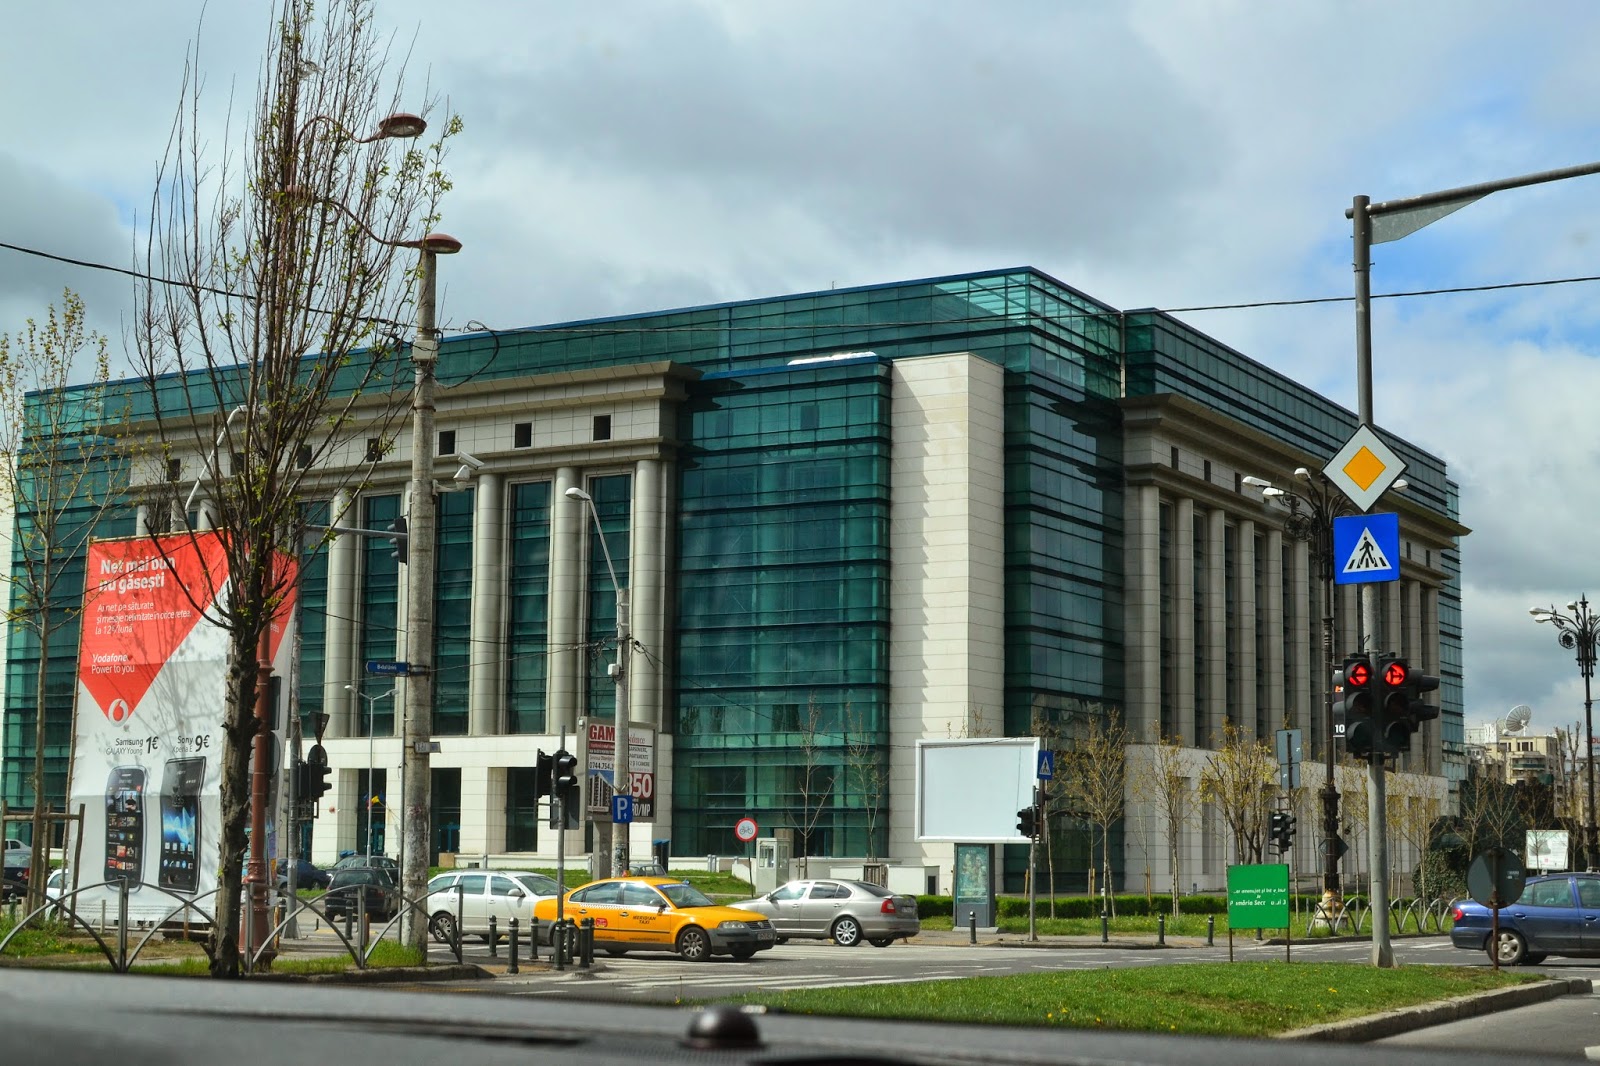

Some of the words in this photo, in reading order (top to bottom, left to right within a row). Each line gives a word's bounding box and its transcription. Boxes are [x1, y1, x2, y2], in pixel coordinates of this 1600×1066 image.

[100, 559, 124, 574] Net
[126, 555, 148, 573] mai
[151, 556, 176, 570] bun
[99, 580, 116, 592] nu
[118, 572, 164, 594] găsești
[92, 653, 128, 663] Vodafone
[92, 664, 112, 674] Power
[114, 664, 121, 673] to
[122, 664, 135, 676] you
[1334, 724, 1346, 734] 10
[116, 738, 144, 748] Samsung
[178, 735, 194, 744] Sony
[195, 734, 210, 752] 9€
[617, 798, 628, 820] P
